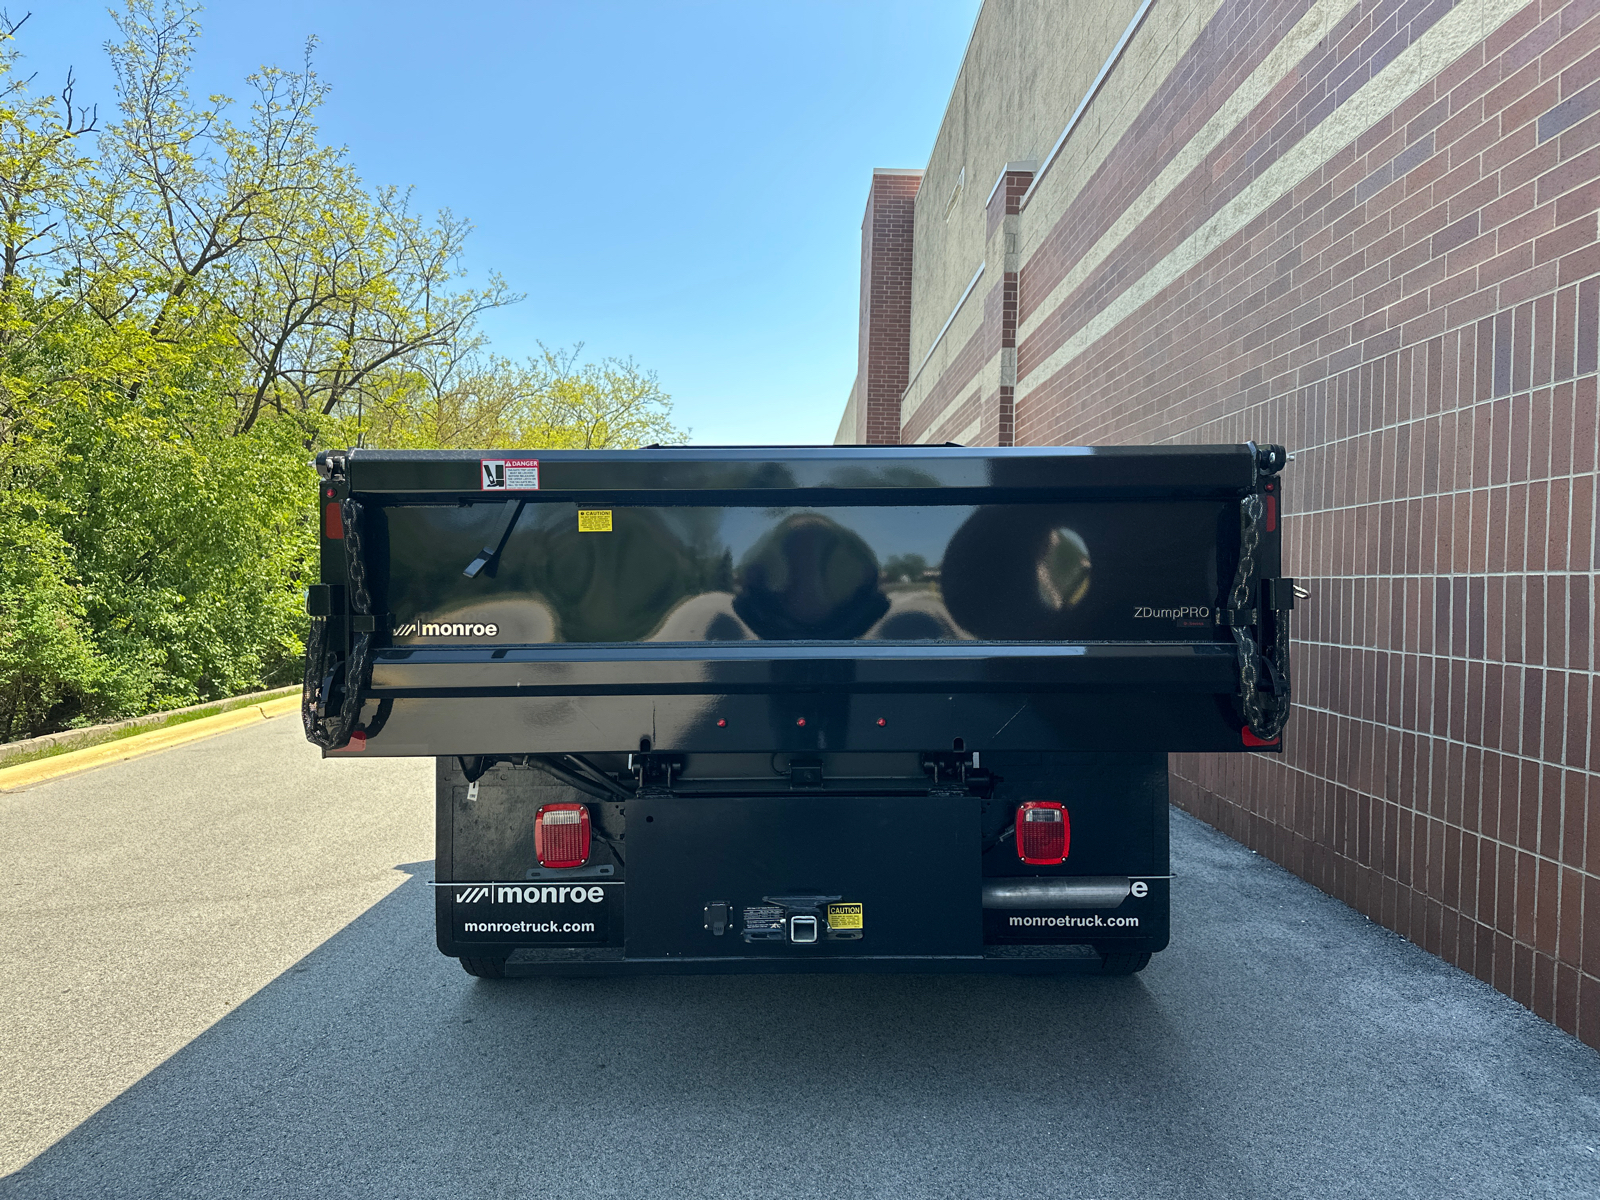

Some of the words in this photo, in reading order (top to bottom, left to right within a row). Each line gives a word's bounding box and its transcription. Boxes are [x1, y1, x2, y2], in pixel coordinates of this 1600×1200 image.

[1133, 606, 1210, 620] ZDumpPRO
[421, 623, 498, 637] monroe
[497, 886, 605, 904] monroe
[830, 906, 861, 914] CAUTION
[464, 920, 595, 933] monroetruck.com
[1009, 914, 1140, 927] monroetruck.com
